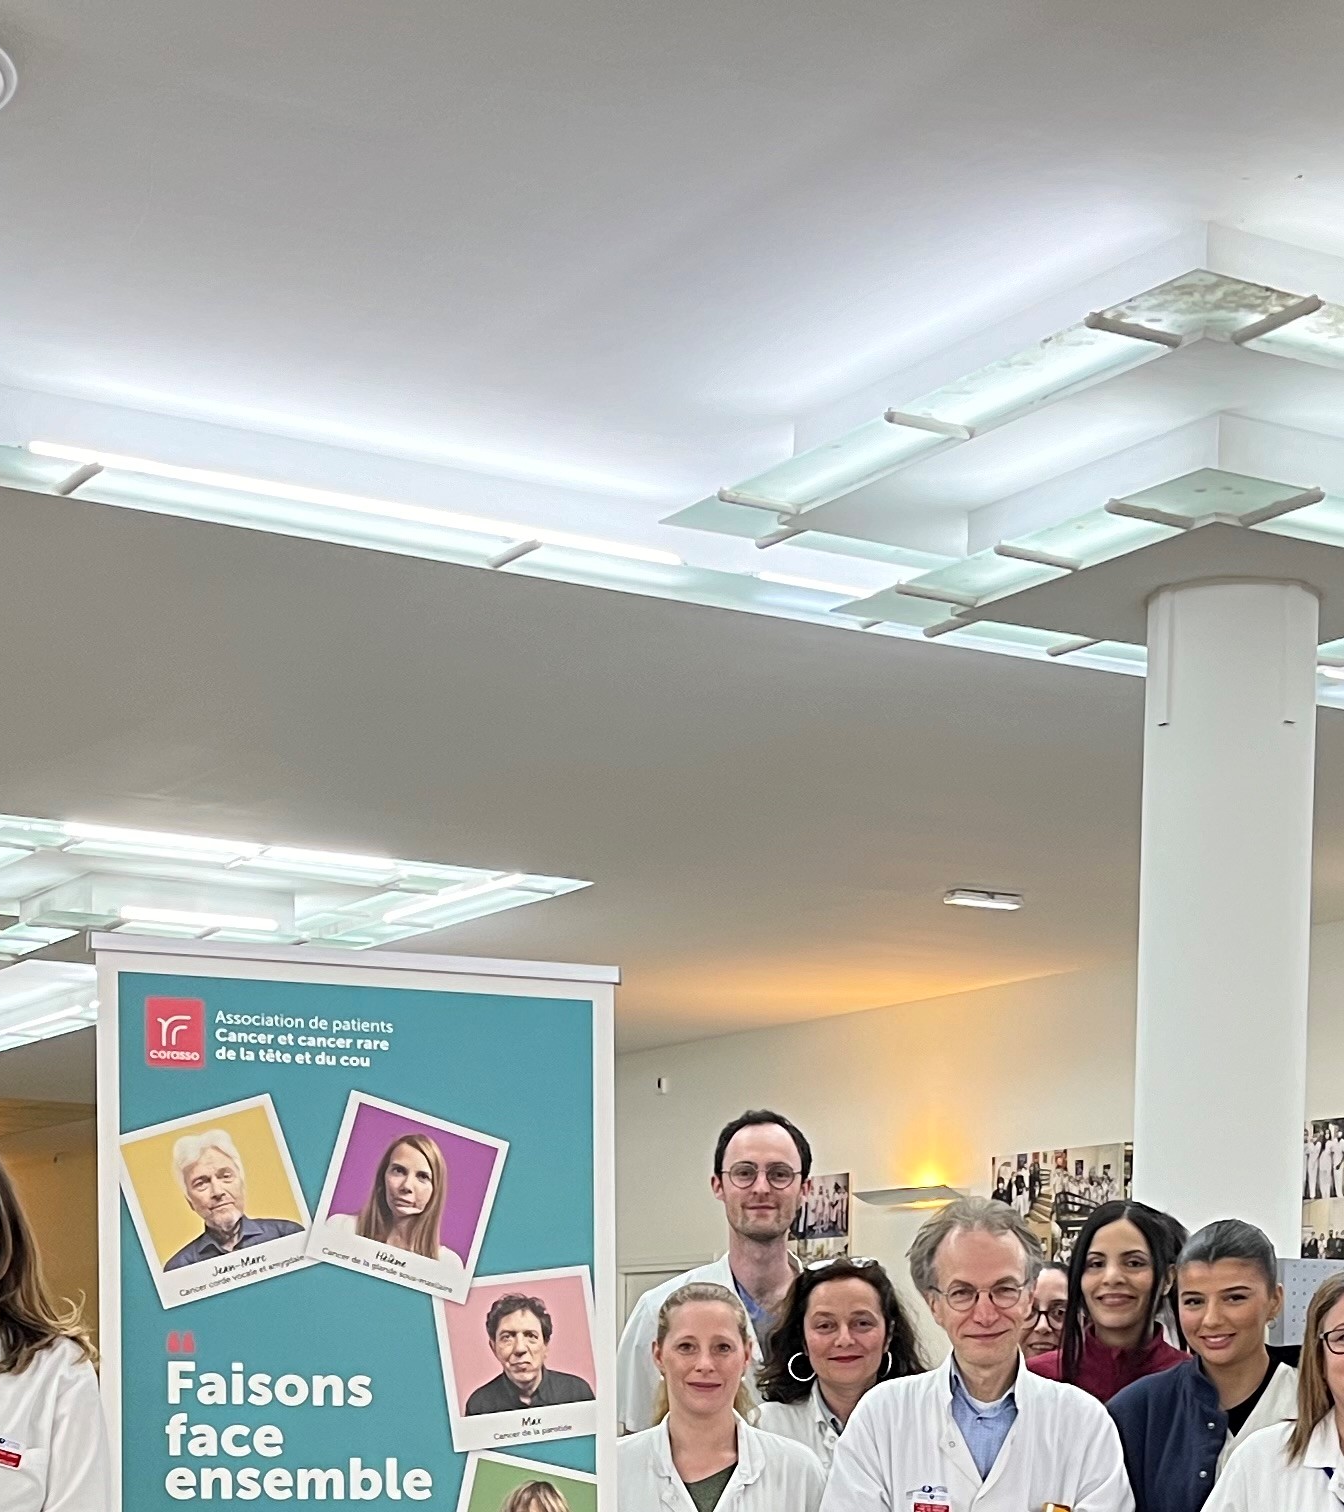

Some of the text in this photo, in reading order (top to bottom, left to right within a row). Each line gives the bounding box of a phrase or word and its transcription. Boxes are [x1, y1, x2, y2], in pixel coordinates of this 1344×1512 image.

[215, 1010, 393, 1034] Association de patients
[215, 1028, 389, 1051] Cancer et cancer rare
[149, 1049, 200, 1061] corasso
[215, 1046, 371, 1067] de la tête et du cou
[212, 1254, 267, 1277] Jean-Marc
[322, 1247, 349, 1260] Cancer
[351, 1256, 361, 1264] de
[363, 1259, 370, 1267] la
[372, 1263, 397, 1276] glande
[179, 1284, 207, 1297] Cancer
[167, 1361, 374, 1408] Faisons
[521, 1416, 542, 1427] Max
[165, 1412, 284, 1458] face
[493, 1431, 521, 1440] Cancer
[164, 1457, 434, 1501] ensemble
